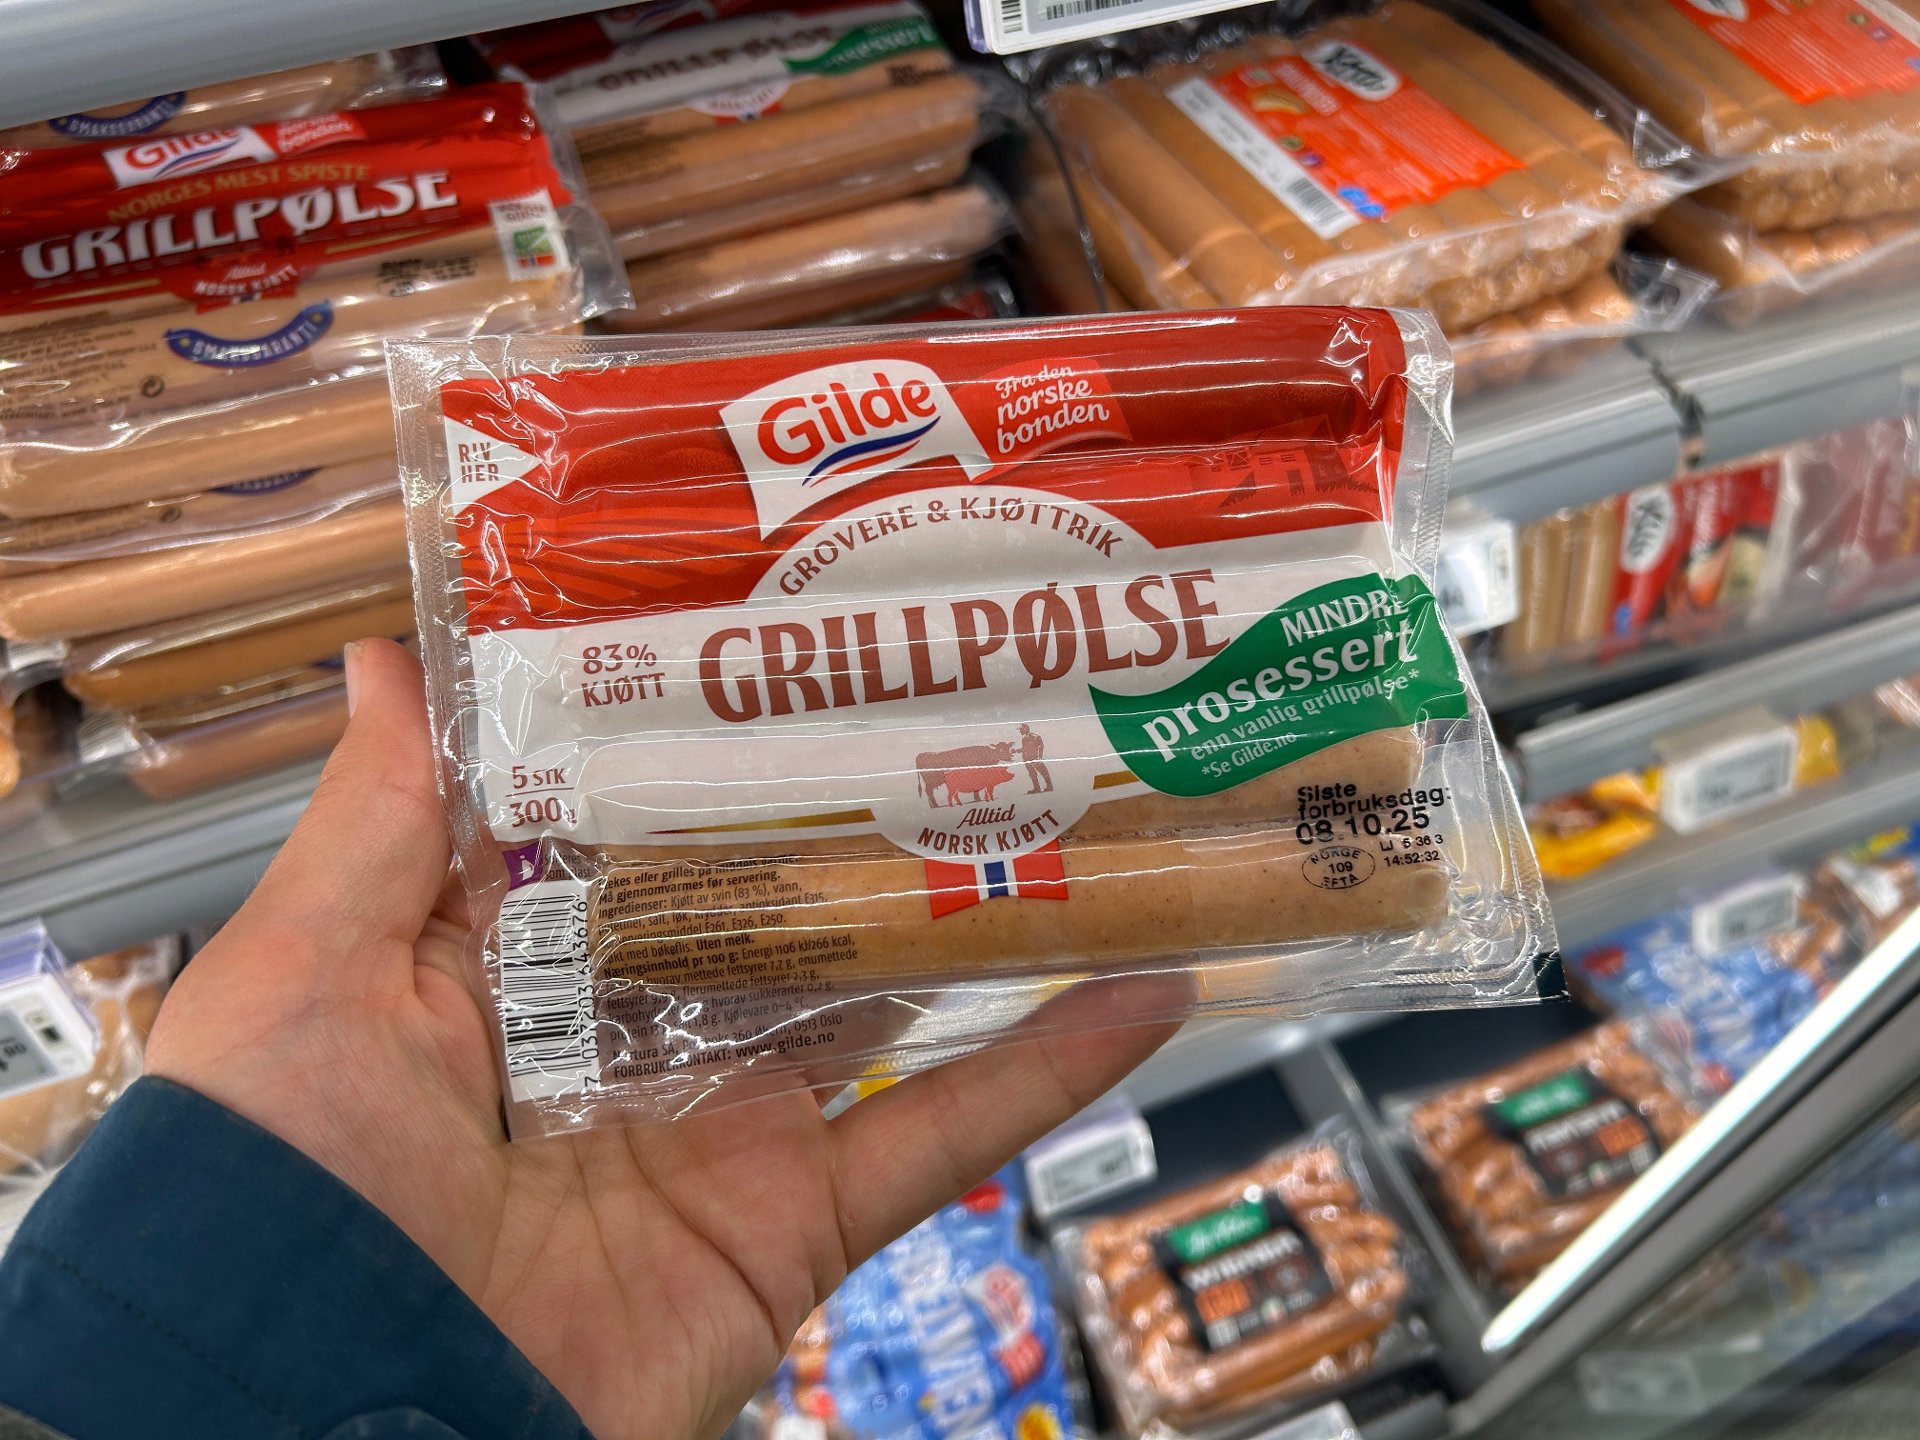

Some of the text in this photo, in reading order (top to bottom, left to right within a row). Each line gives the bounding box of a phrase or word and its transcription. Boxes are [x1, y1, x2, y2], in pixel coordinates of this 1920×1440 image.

[107, 164, 370, 221] NORGES MEST SPISTE
[21, 171, 458, 280] GRILLPØLSE
[995, 363, 1075, 399] Fra den
[757, 372, 937, 466] Gilde
[997, 378, 1093, 425] norske
[997, 400, 1110, 454] bonden
[458, 442, 491, 463] RIV
[461, 464, 500, 483] HER
[779, 496, 1123, 596] GROVERE & KJØTTRIK
[582, 643, 657, 675] 83%
[699, 568, 1231, 723] GRILLPØLSE
[581, 673, 666, 707] KJØTT
[1142, 617, 1419, 763] prosessert
[1190, 731, 1232, 762] enn
[1233, 703, 1302, 739] vanlig
[512, 766, 528, 789] 5
[1297, 783, 1357, 804] Siste
[956, 804, 1016, 829] Alltid
[1298, 786, 1451, 821] forbruksdag:
[917, 810, 1060, 855] NORSK KJØTT
[1328, 861, 1354, 874] 109
[1384, 850, 1440, 868] 14:52:32
[600, 876, 631, 890] ekes
[634, 871, 659, 884] eller
[662, 867, 695, 880] grilles
[617, 881, 704, 904] gjennomvarmes
[707, 877, 723, 888] før
[727, 870, 781, 886] servering.
[599, 881, 802, 919] Ingredienser: Kjøtt av svin (83 %), vann,
[603, 955, 689, 979] Næringsinnhold
[691, 956, 704, 968] pr
[707, 952, 726, 965] 100
[728, 951, 740, 963] g:
[741, 944, 773, 960] Energi
[775, 941, 796, 954] 1106
[831, 933, 855, 948] kcal,
[626, 946, 650, 961] med
[651, 941, 694, 958] bøkeflis.
[696, 936, 722, 952] Uten
[725, 933, 756, 947] melk.
[683, 966, 725, 982] mettede
[727, 962, 768, 979] fettsyrer
[797, 948, 858, 967] enumettede
[606, 993, 649, 1010] fettsyrer
[683, 977, 751, 997] flerumettede
[750, 972, 791, 989] fettsyrer
[711, 994, 748, 1010] hvorav
[749, 983, 804, 1001] sukkerarter
[806, 981, 823, 993] 0,2
[610, 1025, 648, 1043] proein
[723, 1005, 770, 1025] Kjølevare
[661, 1042, 680, 1057] SA,
[794, 1018, 818, 1033] 0513
[820, 1013, 843, 1028] Oslo
[735, 1031, 836, 1058] www.gilde.no
